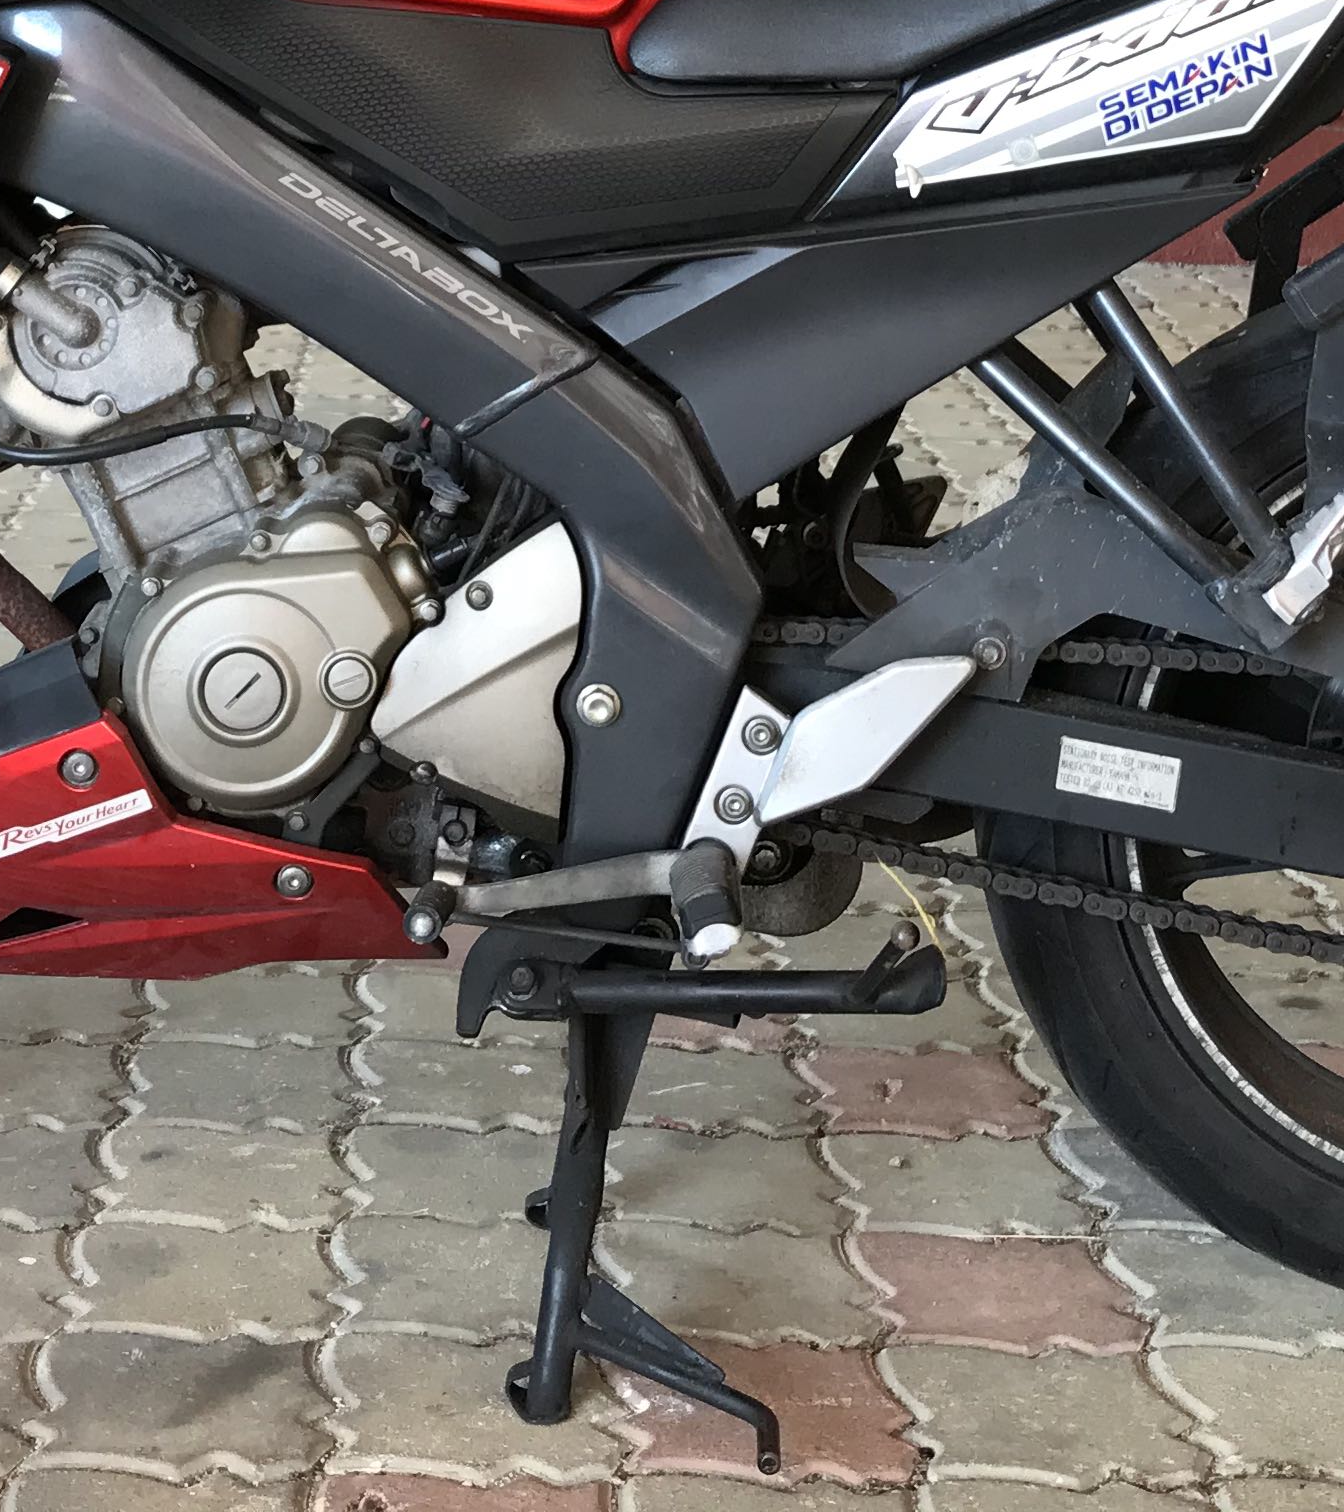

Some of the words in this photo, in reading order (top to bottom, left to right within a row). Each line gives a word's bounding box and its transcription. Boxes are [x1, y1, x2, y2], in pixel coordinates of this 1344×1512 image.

[1147, 56, 1274, 125] DEPAN
[277, 172, 535, 341] DELTABOX
[55, 808, 96, 836] Your
